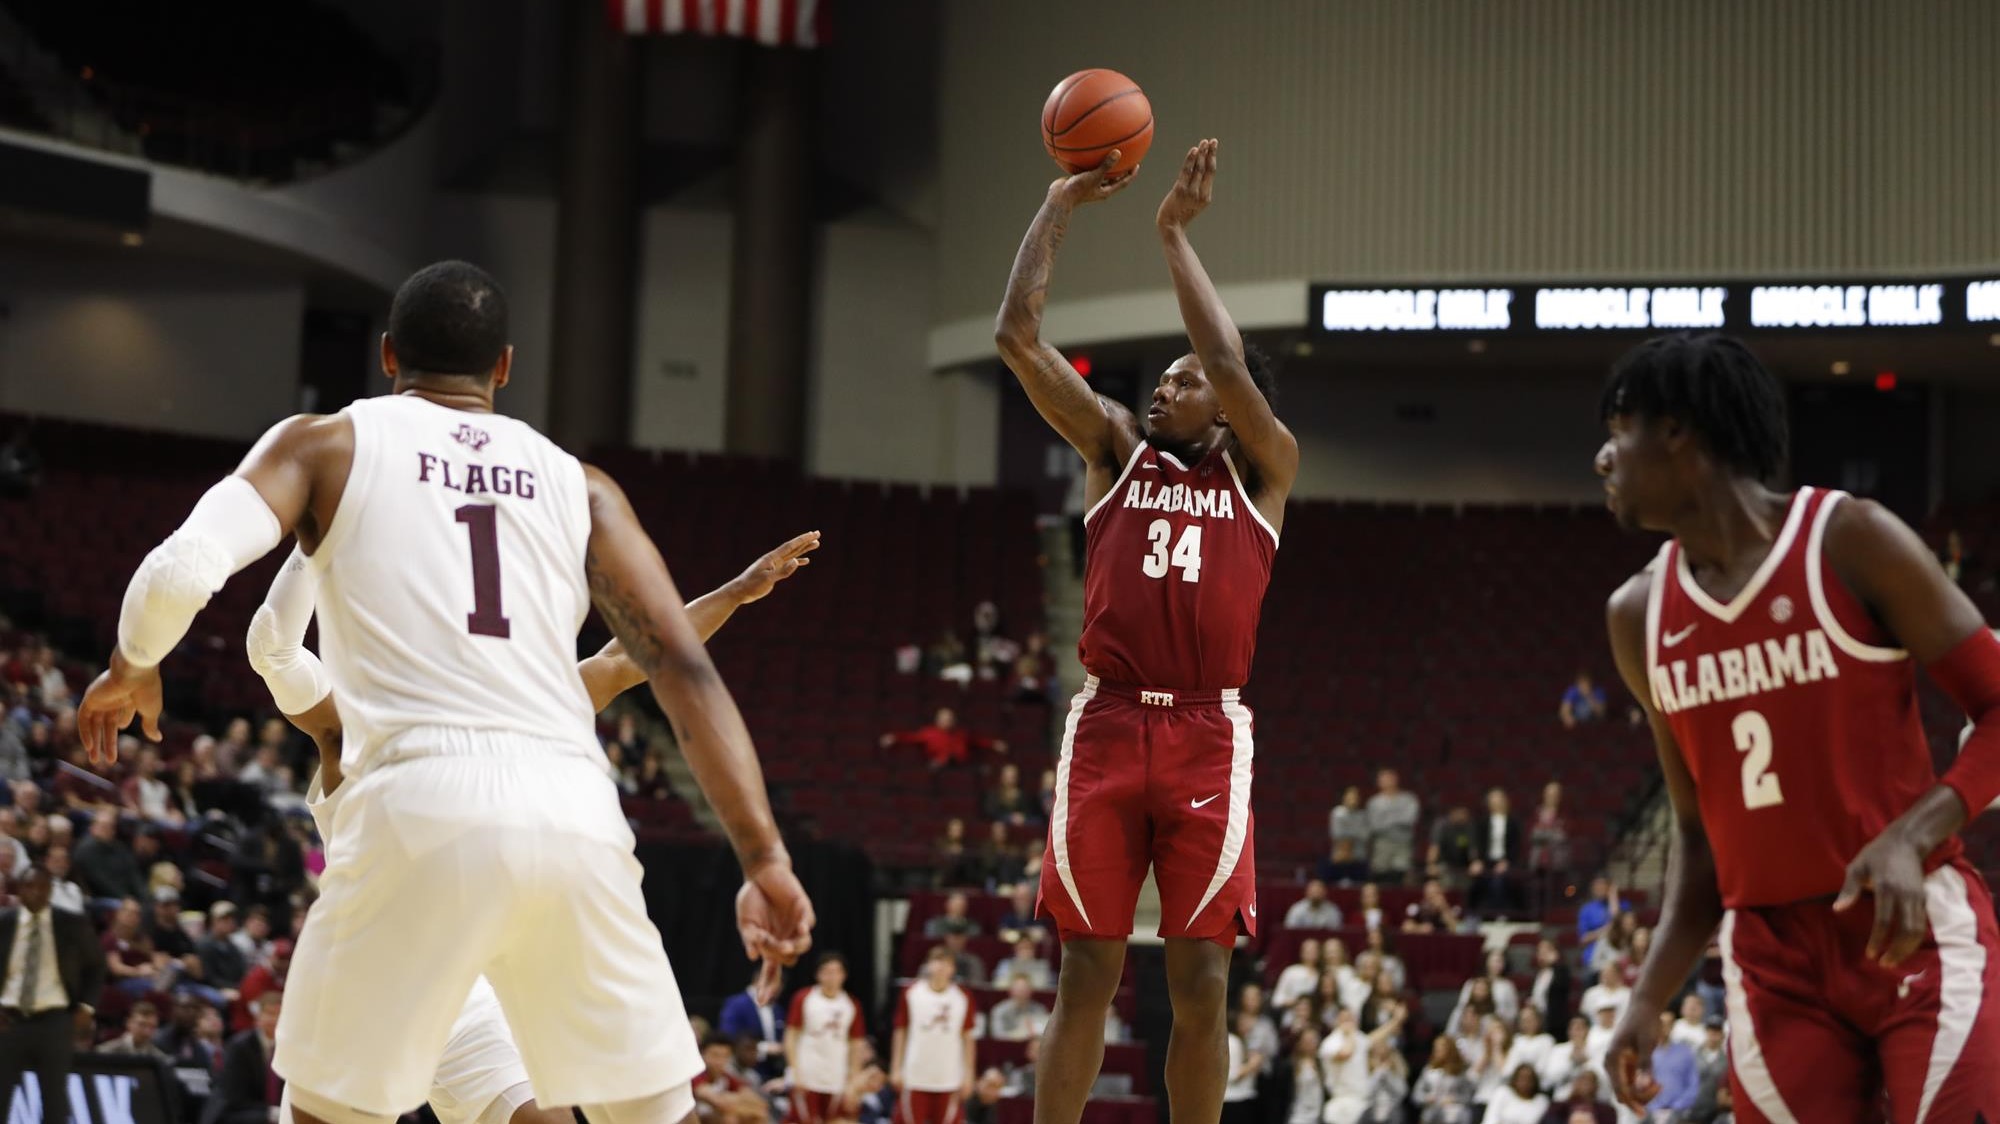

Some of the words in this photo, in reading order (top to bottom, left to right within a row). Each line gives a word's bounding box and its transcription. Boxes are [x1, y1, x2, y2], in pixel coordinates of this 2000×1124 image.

[417, 452, 535, 500] FLAGG
[1123, 480, 1234, 520] ALABAMA
[455, 503, 510, 639] 1
[1142, 518, 1202, 583] 34
[1141, 690, 1174, 707] RTR
[1653, 628, 1839, 714] ALABAMA
[1731, 709, 1784, 810] 2
